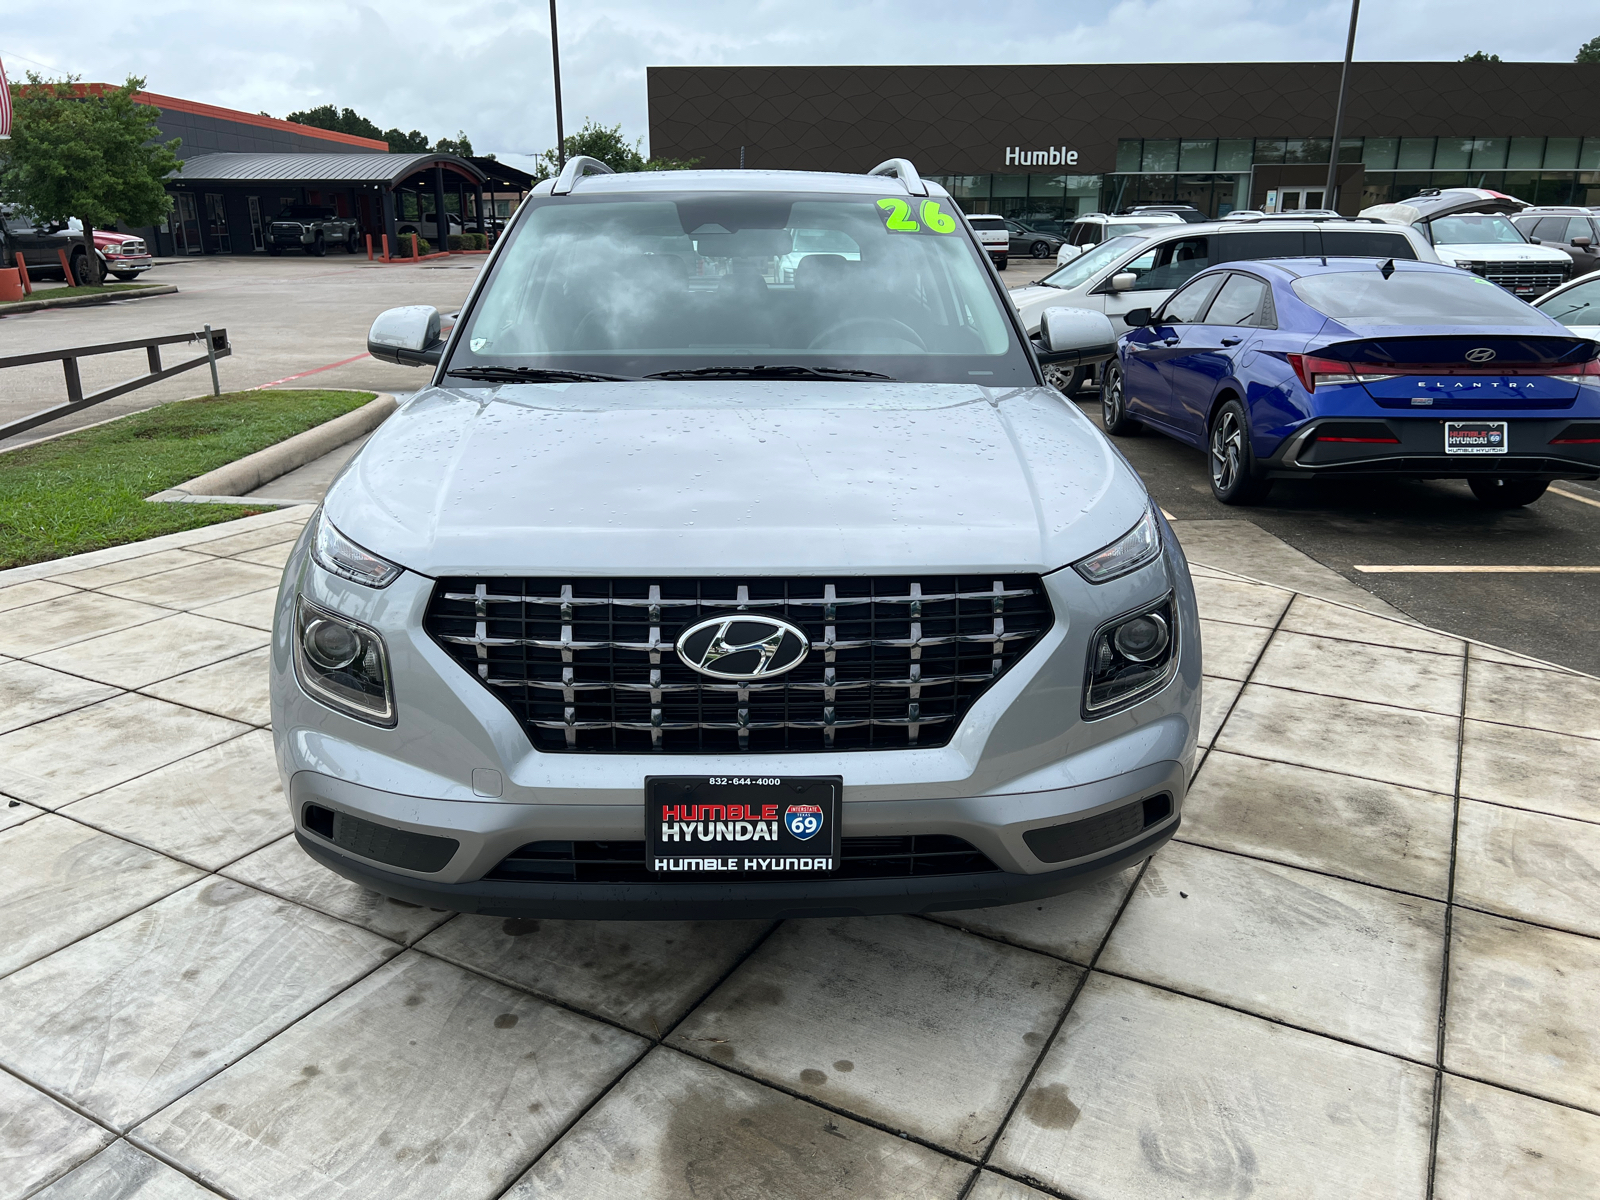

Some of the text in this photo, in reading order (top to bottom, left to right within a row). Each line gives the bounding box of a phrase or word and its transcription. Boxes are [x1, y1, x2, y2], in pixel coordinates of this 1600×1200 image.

[1005, 146, 1078, 165] Humble
[876, 198, 956, 233] 26
[709, 777, 781, 785] 832-644-4000
[662, 804, 779, 821] HUMBLE
[661, 821, 779, 842] HYUNDAI
[791, 817, 817, 833] 69
[654, 858, 833, 871] HUMBLE HYUNDAI
